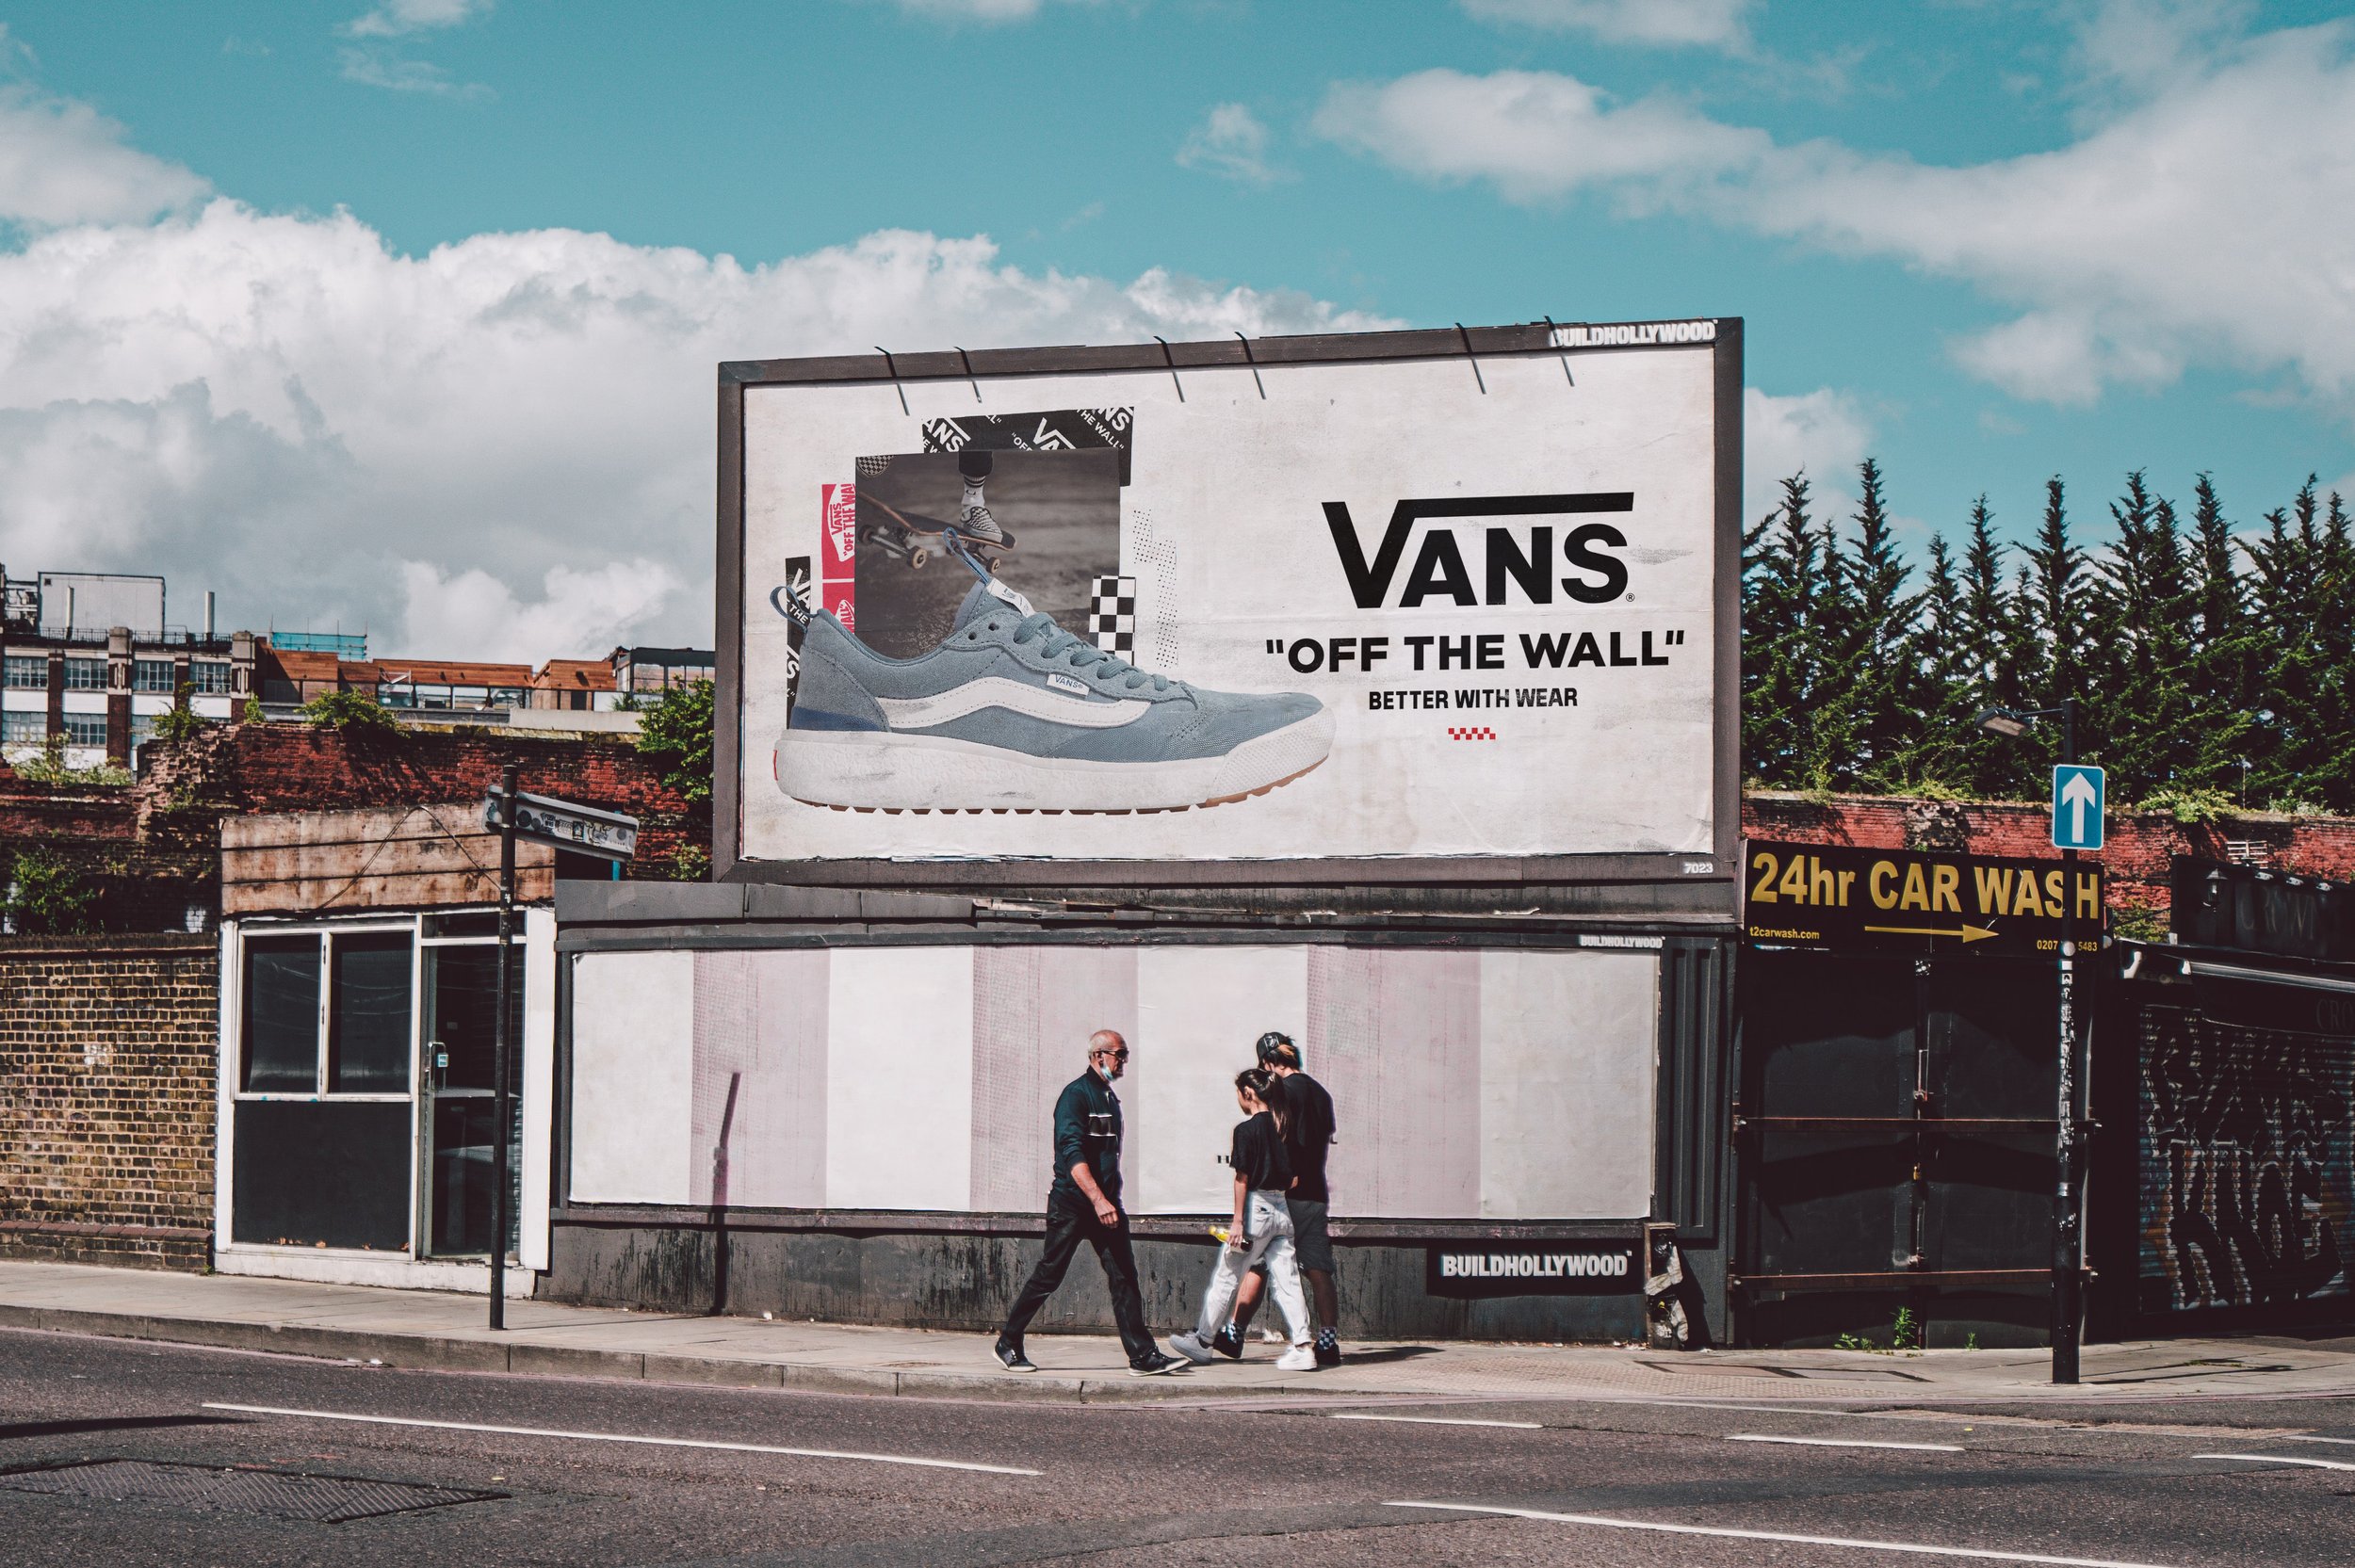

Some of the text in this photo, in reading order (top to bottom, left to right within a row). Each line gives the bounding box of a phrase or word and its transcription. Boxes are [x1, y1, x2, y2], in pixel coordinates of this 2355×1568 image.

[1550, 321, 1715, 347] BUILDHOLLYWOOD
[1032, 417, 1077, 450] VA
[1095, 422, 1125, 449] WALL"
[829, 502, 843, 535] VANS
[1321, 492, 1634, 609] VANS
[789, 604, 808, 623] THE
[1266, 630, 1685, 673] "OFF THE WALL"
[1054, 674, 1079, 688] VANS
[1369, 687, 1578, 711] BETTER WITH WEAR
[1682, 861, 1714, 874] 7023
[1750, 852, 2099, 920] 24hr CAR WASH
[1580, 934, 1664, 948] BUILDHOLLYWOOD
[1749, 926, 1820, 940] t2carwash.com
[2036, 939, 2059, 950] 0207
[1442, 1254, 1628, 1277] BUILDHOLLYWOOD
